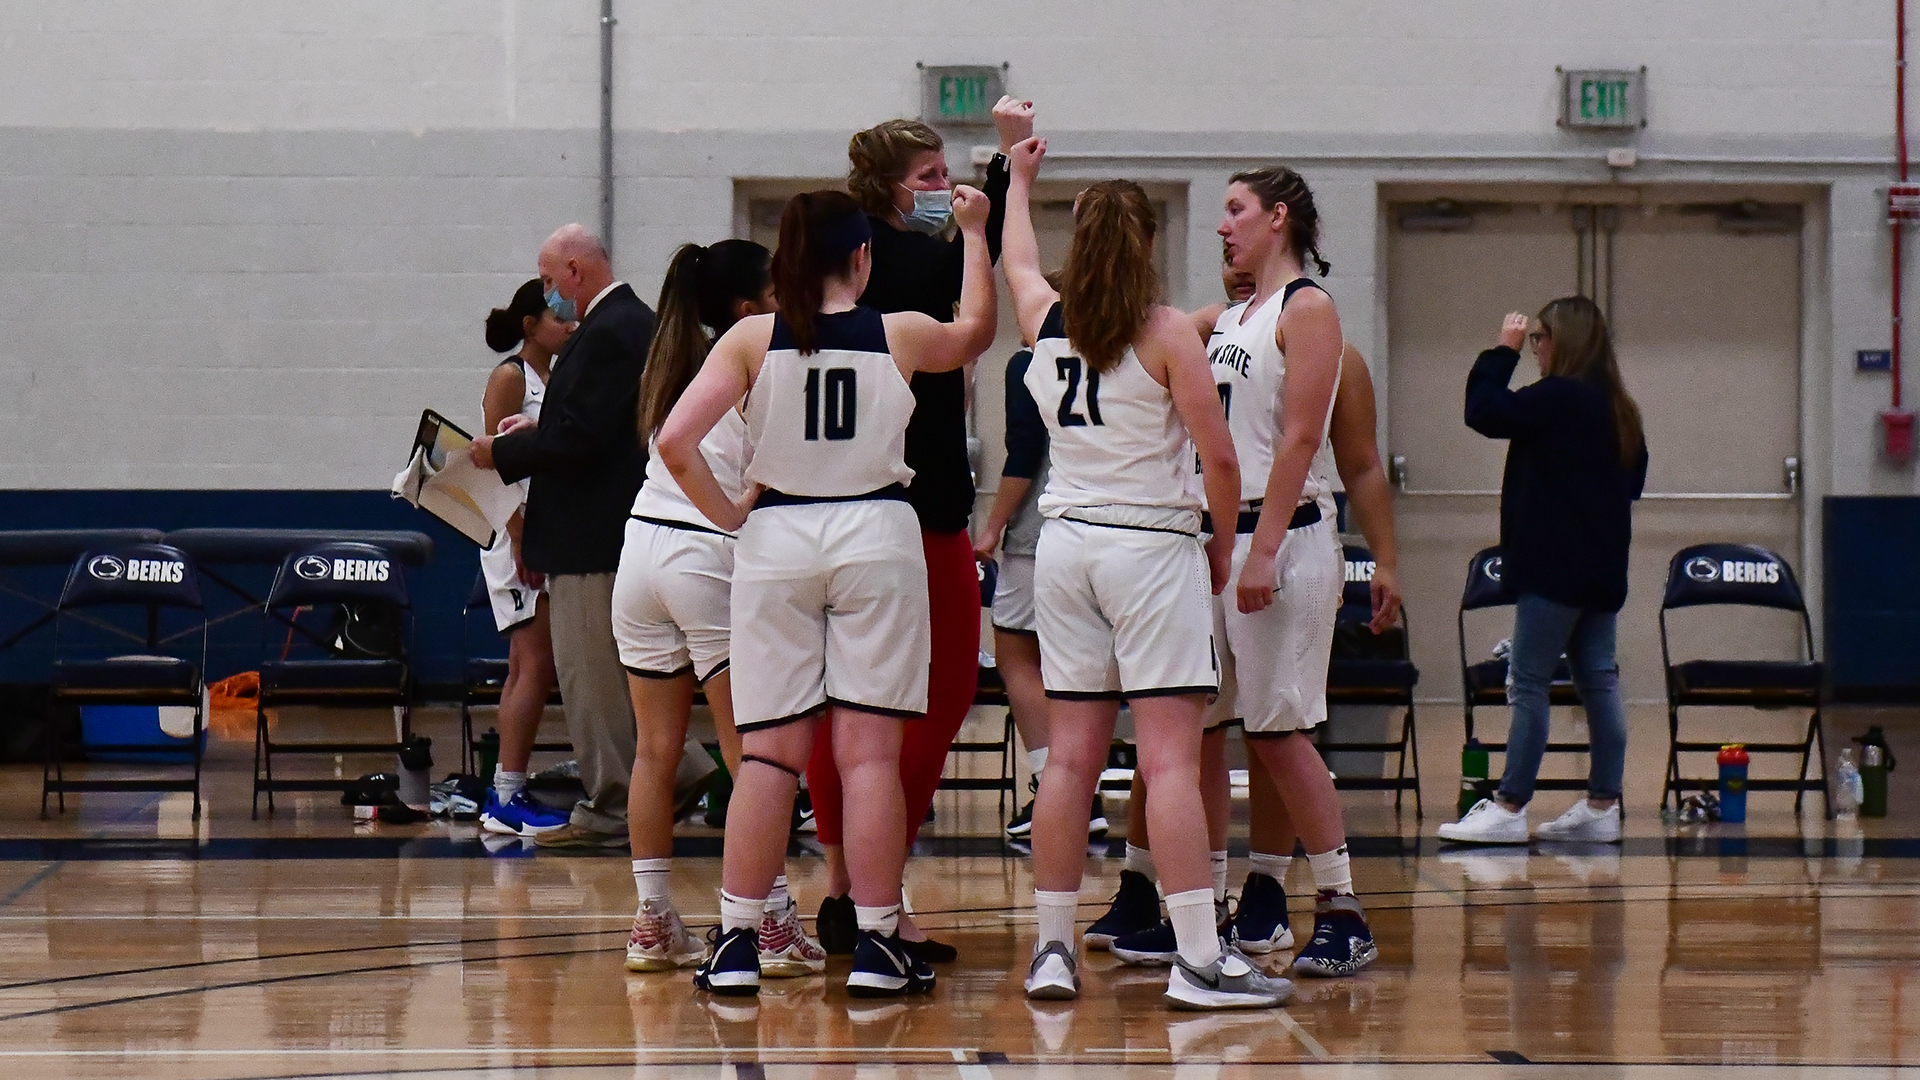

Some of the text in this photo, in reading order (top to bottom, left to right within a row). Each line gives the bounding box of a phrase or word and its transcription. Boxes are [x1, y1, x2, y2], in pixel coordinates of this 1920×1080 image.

[940, 76, 988, 115] EXIT
[1581, 80, 1628, 118] EXIT
[1218, 343, 1252, 379] STATE
[803, 367, 857, 441] 10
[1055, 356, 1105, 427] 21
[126, 559, 185, 583] BERKS
[333, 559, 390, 582] BERKS
[1344, 560, 1377, 582] RKS
[1722, 560, 1780, 584] BERKS
